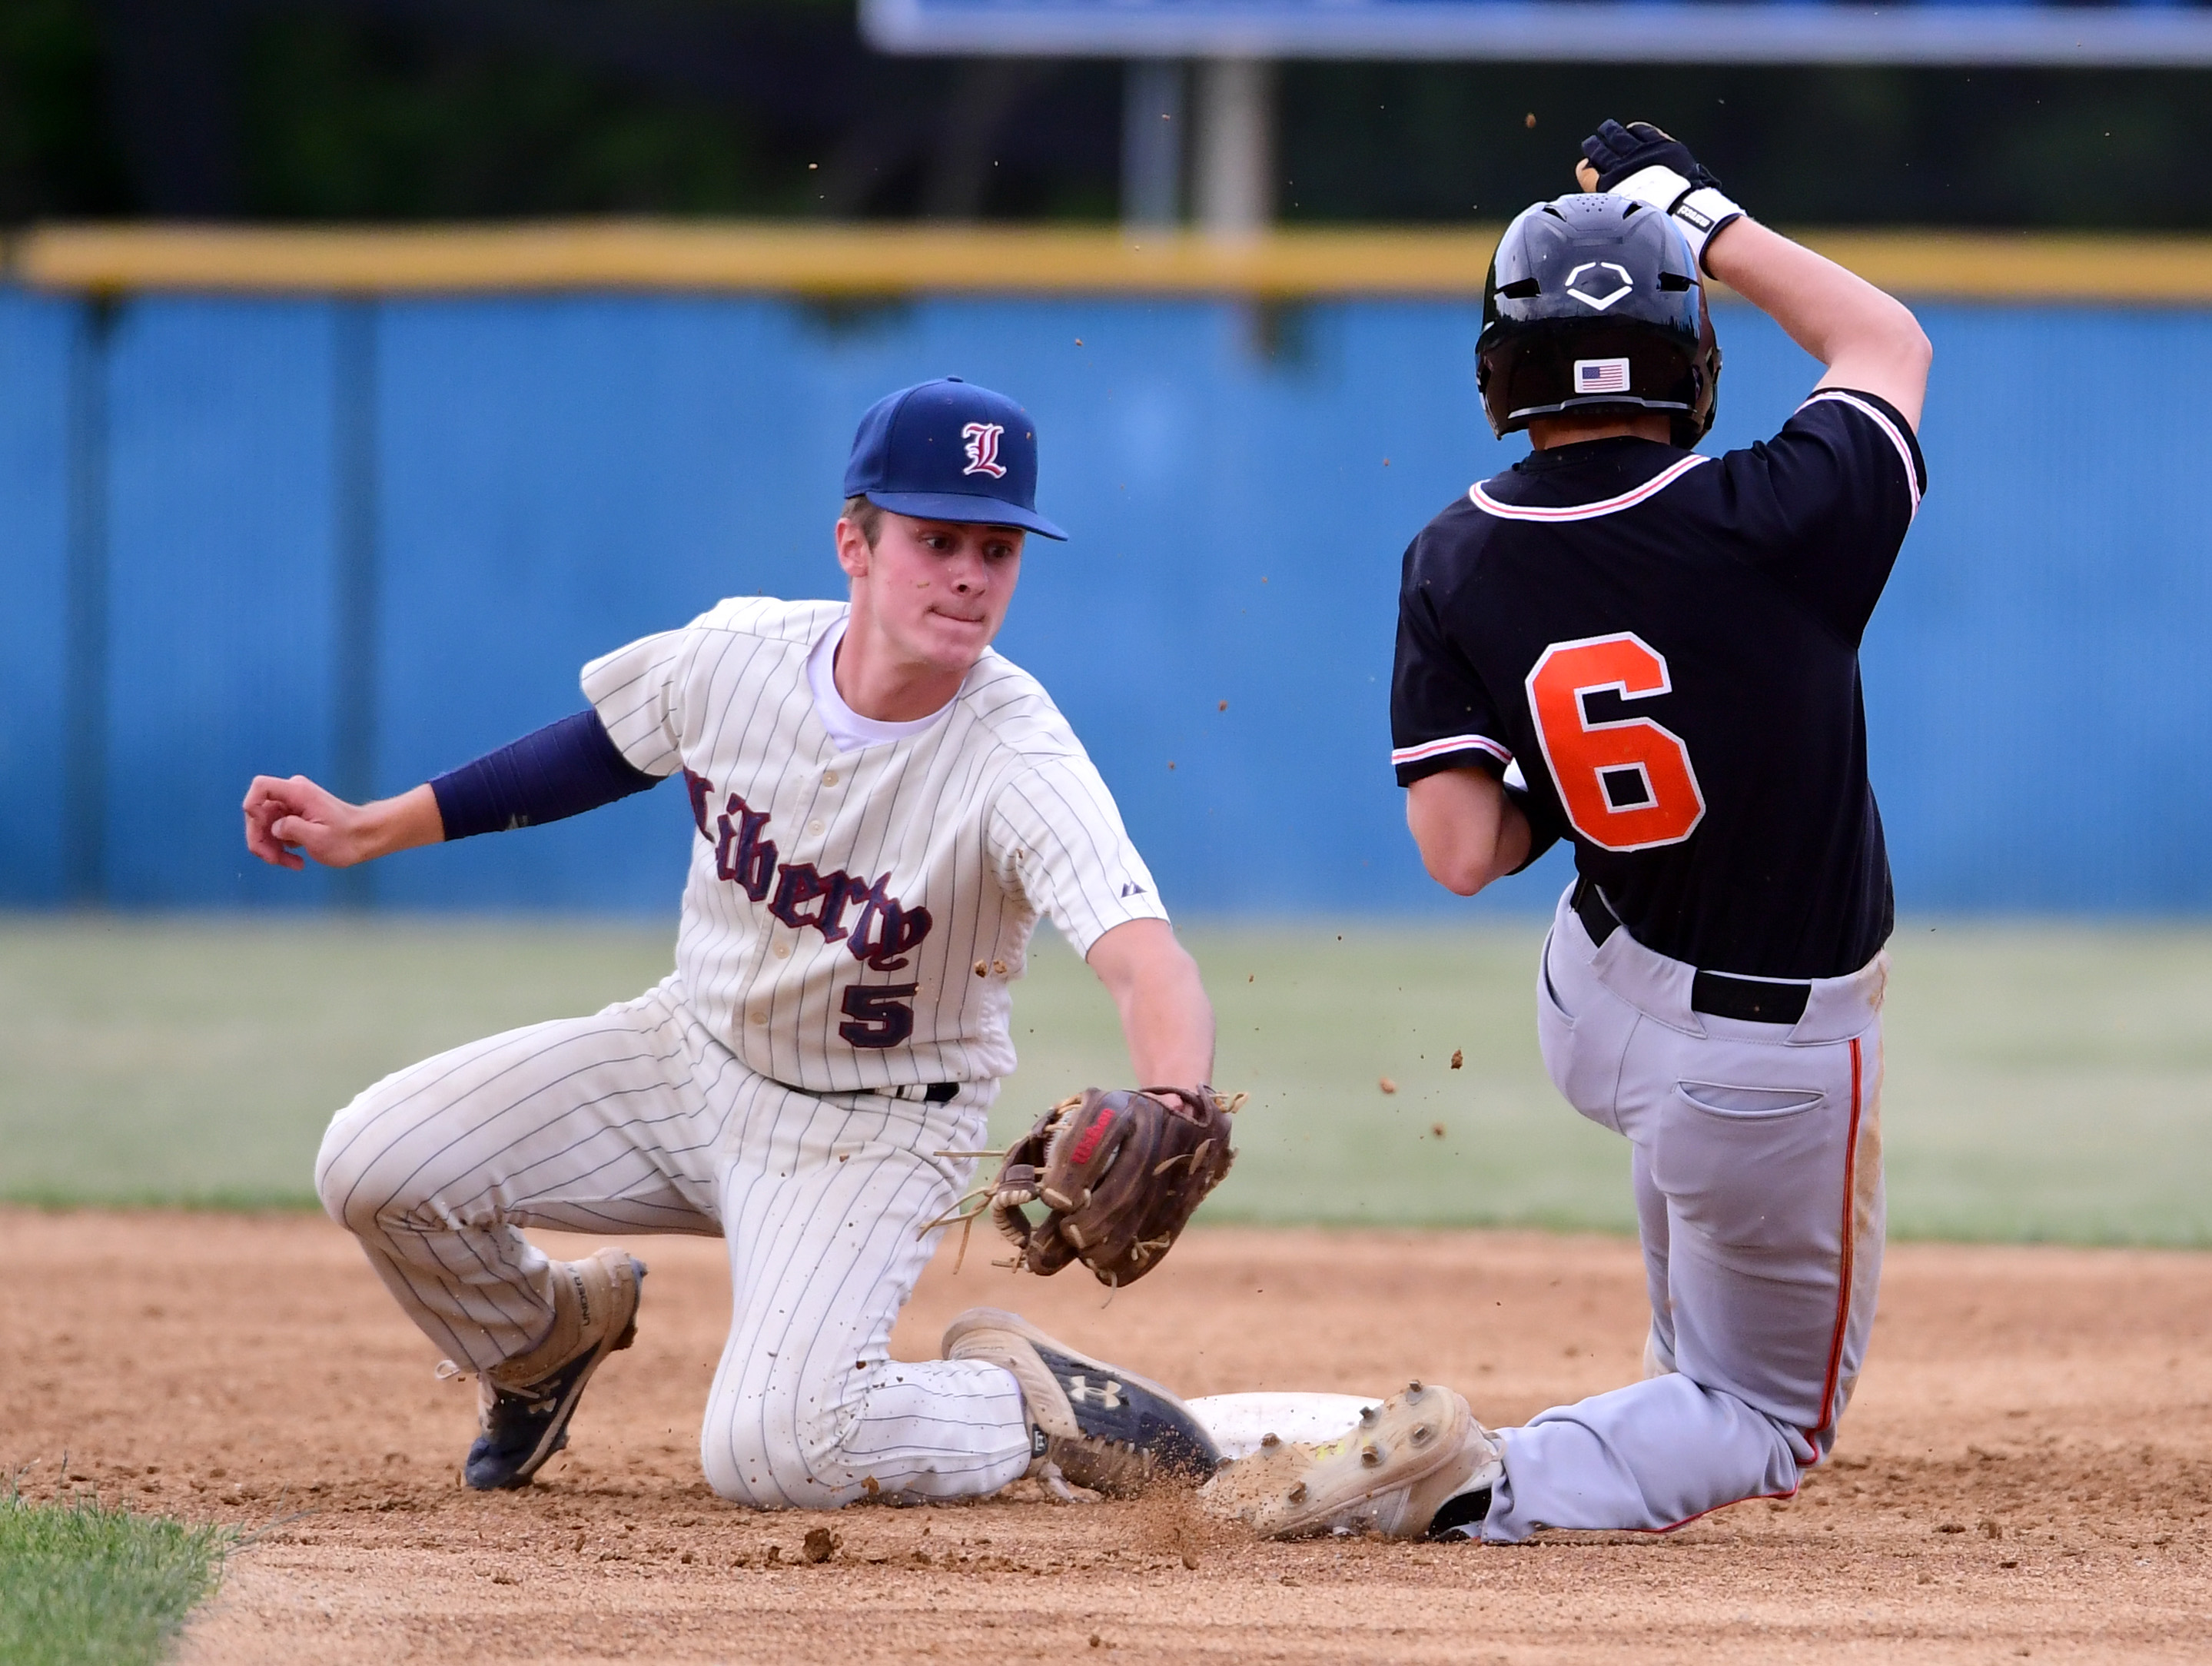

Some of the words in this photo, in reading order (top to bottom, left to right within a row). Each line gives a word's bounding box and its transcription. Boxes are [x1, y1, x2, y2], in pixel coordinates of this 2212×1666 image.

[1677, 205, 1711, 228] marucci
[962, 423, 1007, 478] L
[1525, 630, 1706, 853] 6
[839, 983, 919, 1048] 5
